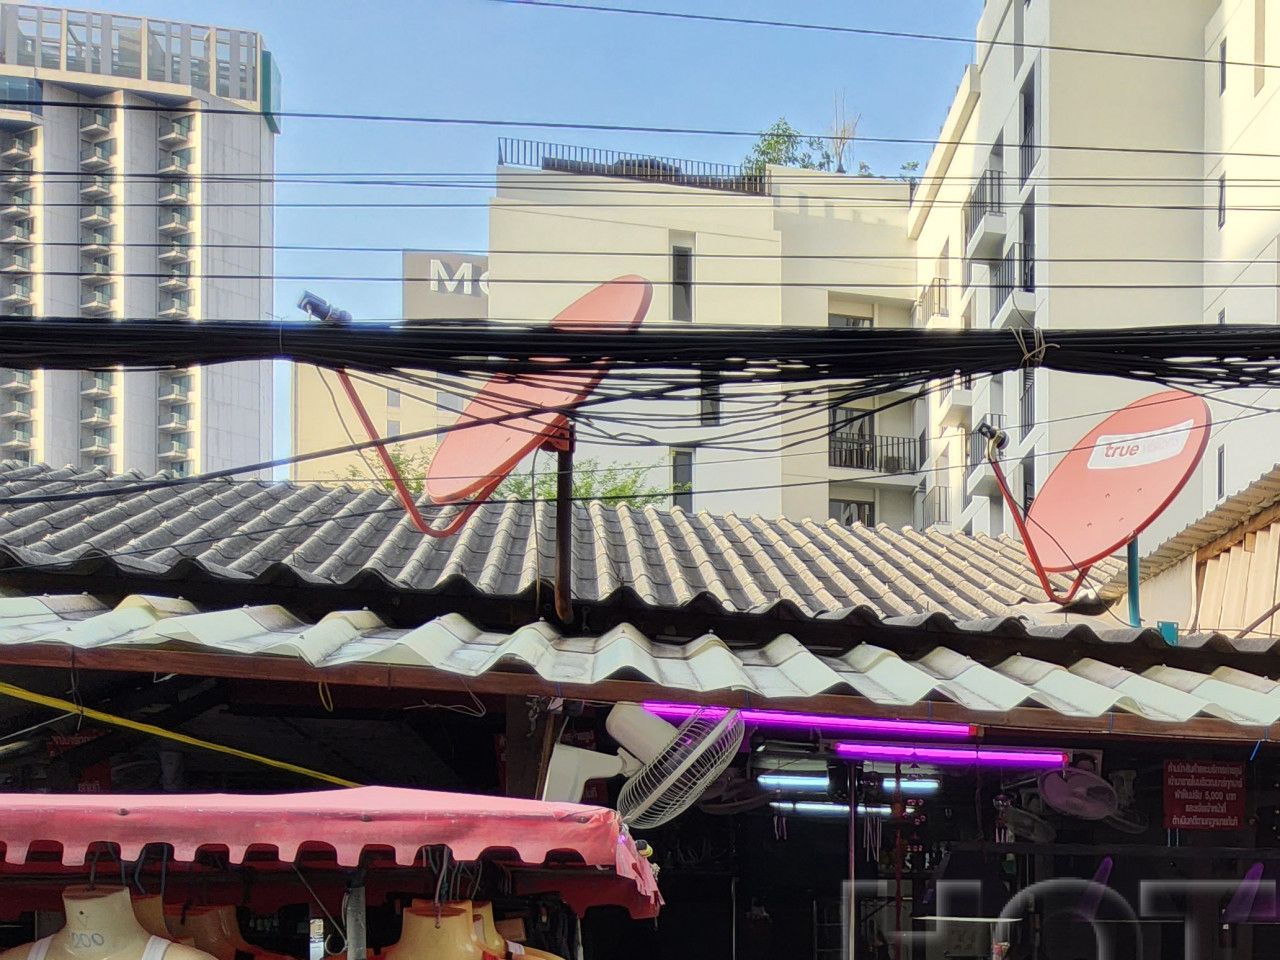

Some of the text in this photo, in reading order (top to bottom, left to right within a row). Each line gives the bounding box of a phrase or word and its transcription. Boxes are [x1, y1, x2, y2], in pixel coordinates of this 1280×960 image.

[1104, 444, 1139, 458] true
[1205, 791, 1224, 801] 5,000
[71, 932, 105, 948] 200
